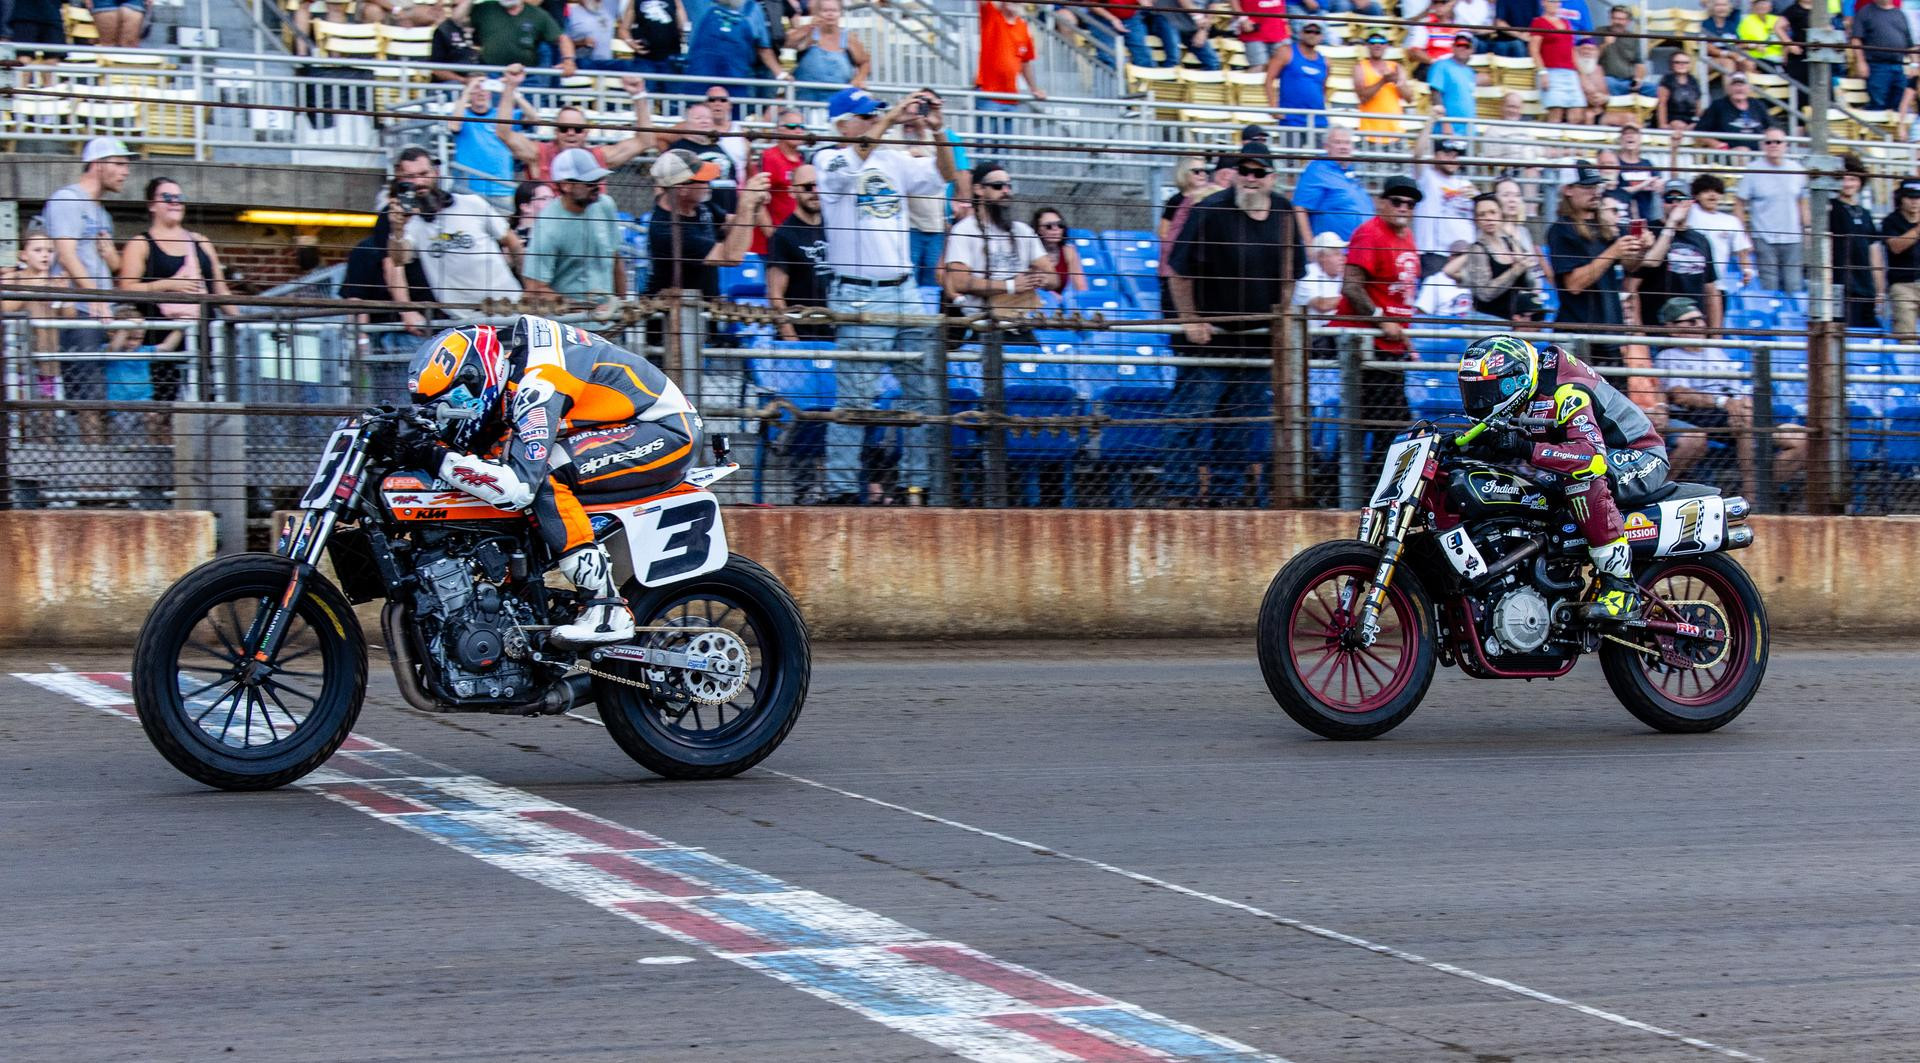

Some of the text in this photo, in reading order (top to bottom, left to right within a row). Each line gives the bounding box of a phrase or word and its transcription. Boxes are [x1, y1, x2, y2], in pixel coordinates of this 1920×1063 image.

[434, 346, 457, 377] 3
[1501, 389, 1529, 416] MONSTER
[579, 437, 666, 475] alpinestars
[1374, 442, 1422, 505] 1
[1481, 480, 1520, 495] Indian
[415, 508, 448, 519] KTM
[1664, 499, 1708, 557] 1
[645, 499, 717, 582] 3
[1677, 623, 1698, 634] RK
